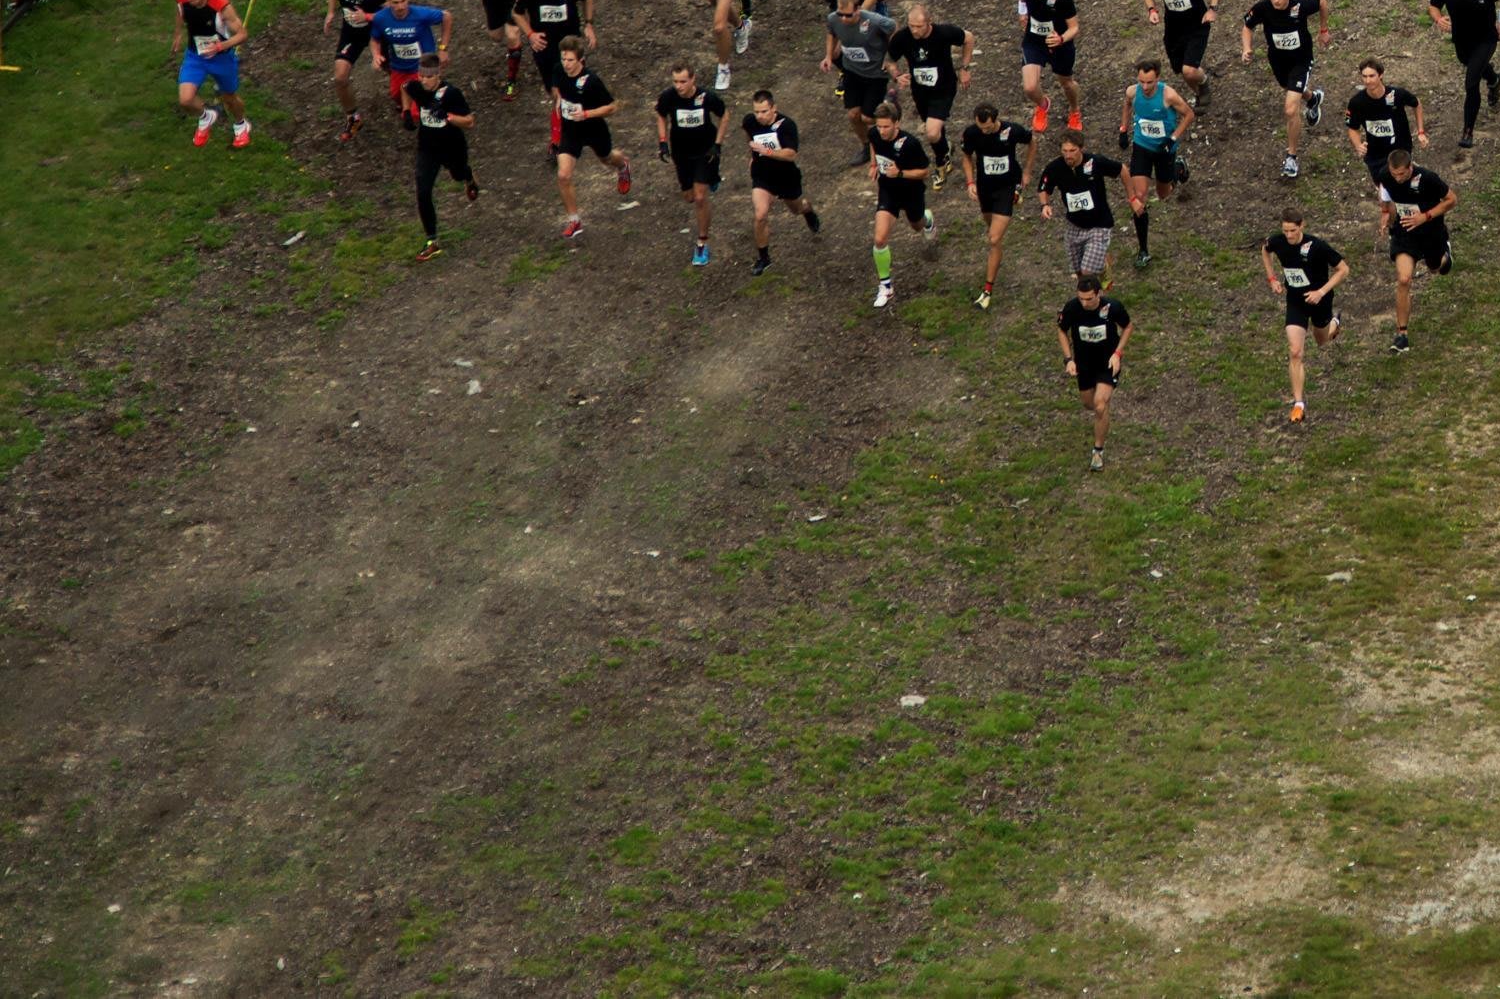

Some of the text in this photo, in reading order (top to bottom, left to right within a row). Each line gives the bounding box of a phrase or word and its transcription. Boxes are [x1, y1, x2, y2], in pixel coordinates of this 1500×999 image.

[1281, 37, 1297, 46] 222
[1374, 125, 1391, 134] 206
[990, 162, 1005, 171] 179
[1074, 198, 1089, 208] 210
